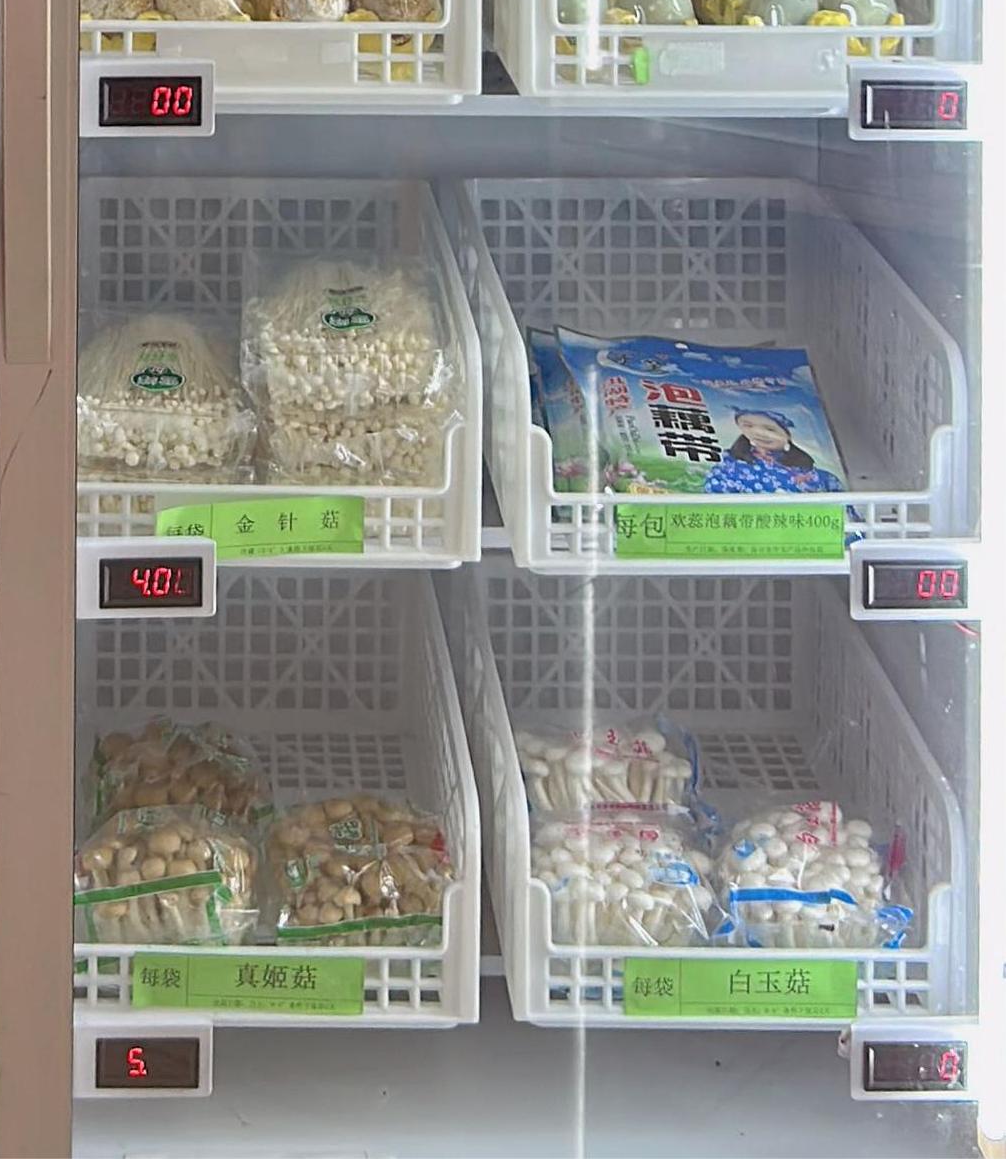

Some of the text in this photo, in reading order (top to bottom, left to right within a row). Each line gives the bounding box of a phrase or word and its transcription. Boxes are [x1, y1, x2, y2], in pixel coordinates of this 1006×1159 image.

[150, 85, 194, 117] 00
[937, 91, 960, 121] 0
[235, 509, 340, 535] 金针菇
[616, 513, 668, 539] 每包
[916, 570, 960, 601] 00
[141, 966, 182, 989] 每袋
[234, 962, 318, 990] 真姬菇
[632, 976, 675, 997] 每袋
[728, 967, 813, 996] 白玉菇
